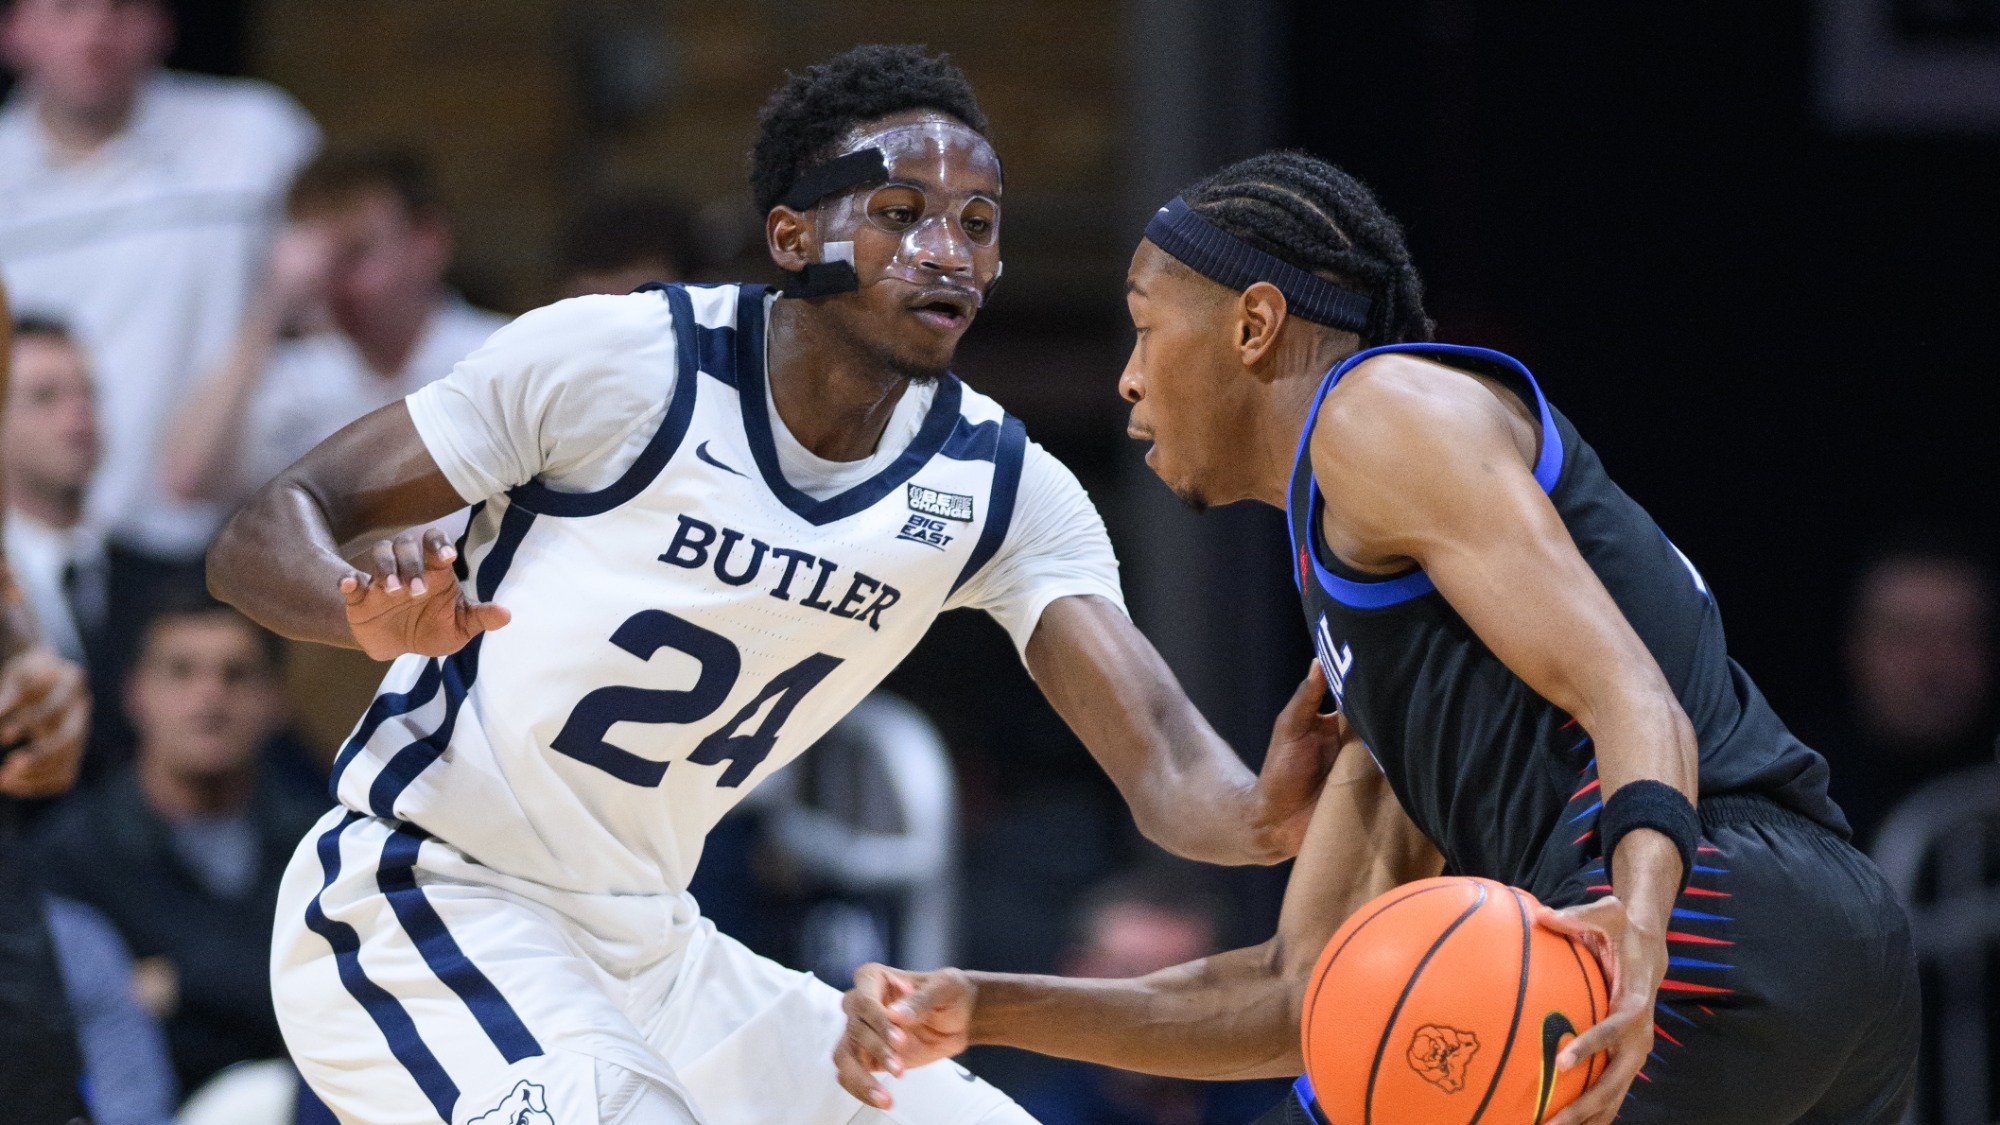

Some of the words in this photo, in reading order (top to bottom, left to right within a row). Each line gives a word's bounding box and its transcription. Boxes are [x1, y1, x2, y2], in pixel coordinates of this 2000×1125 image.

[909, 498, 972, 519] CHANGE
[922, 489, 952, 507] BE
[907, 514, 947, 532] BIG
[900, 524, 954, 546] EAST
[657, 513, 901, 632] BUTLER
[549, 608, 846, 788] 24
